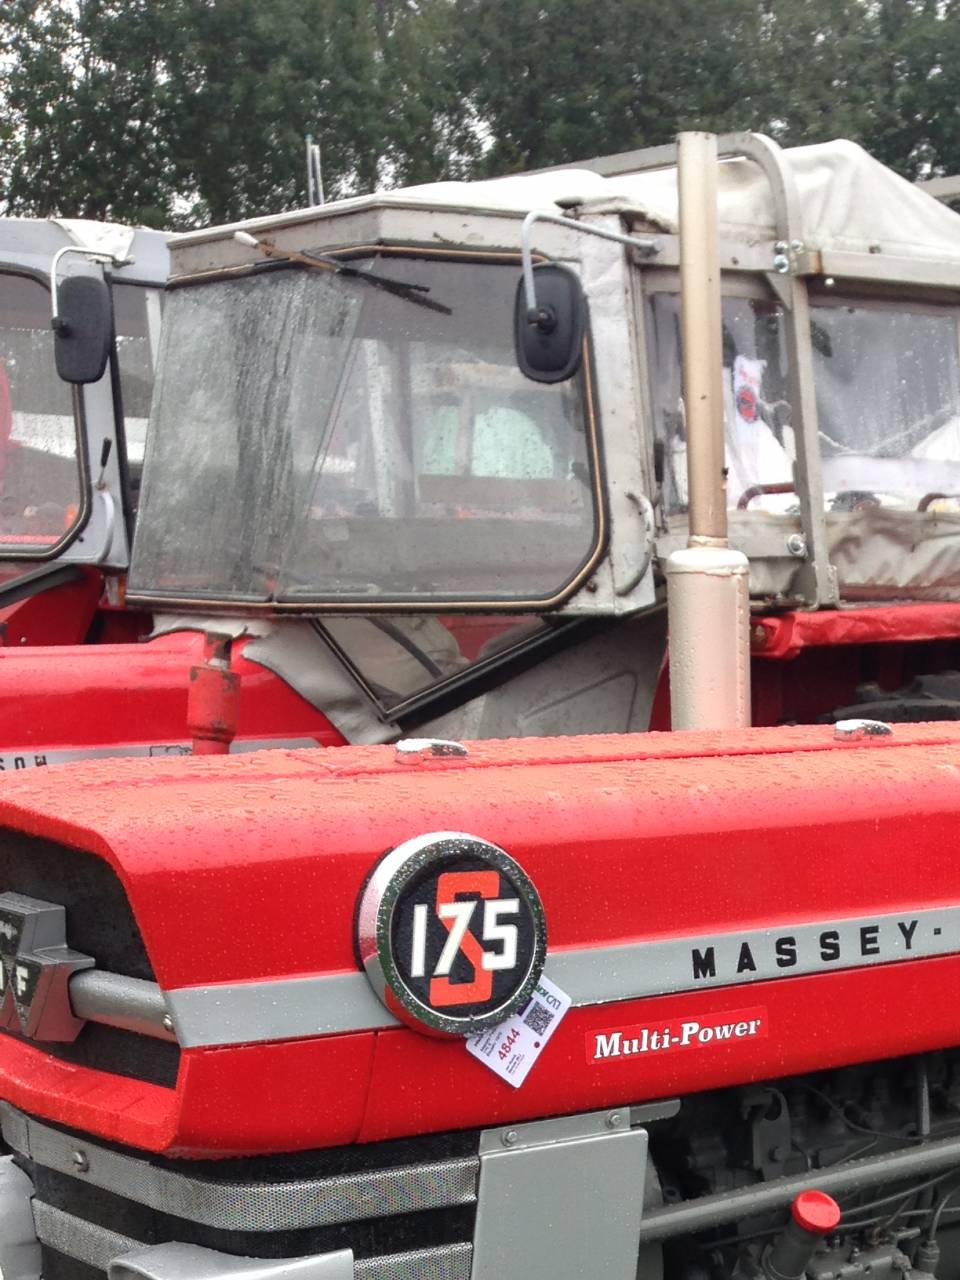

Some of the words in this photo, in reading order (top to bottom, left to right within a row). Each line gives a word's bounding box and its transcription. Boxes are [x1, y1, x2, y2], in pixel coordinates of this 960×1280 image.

[411, 898, 520, 978] 175
[498, 1028, 521, 1061] 4844
[593, 1018, 762, 1060] Multi-Power
